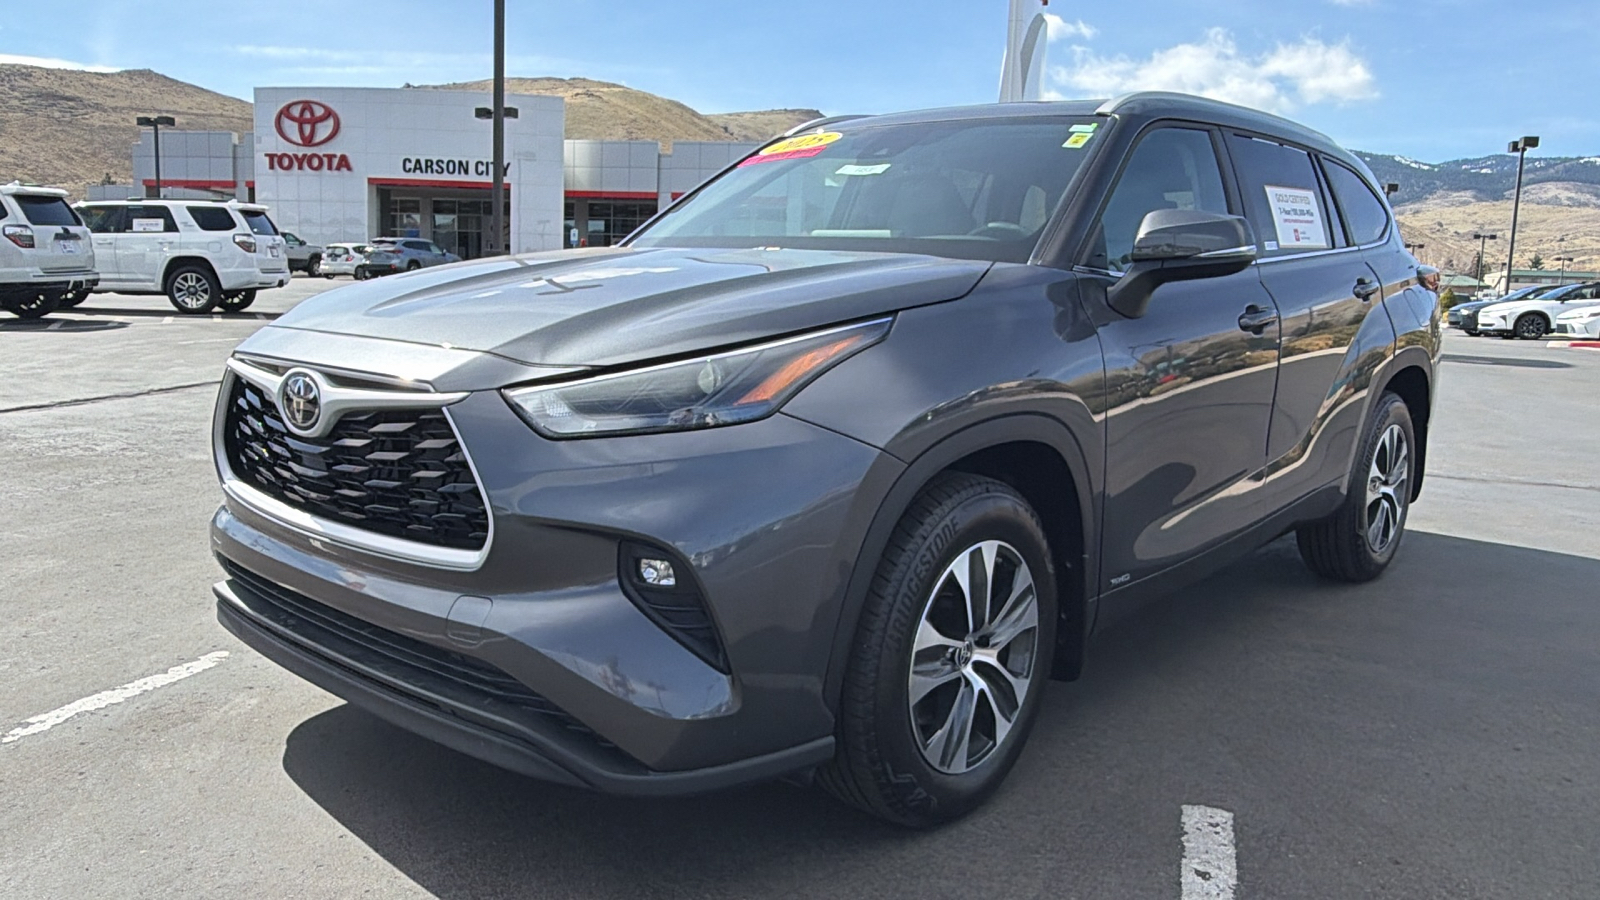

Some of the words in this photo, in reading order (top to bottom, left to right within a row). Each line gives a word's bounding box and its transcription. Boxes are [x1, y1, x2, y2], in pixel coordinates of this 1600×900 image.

[264, 152, 352, 172] TOYOTA
[402, 157, 469, 176] CARSON
[474, 160, 511, 177] CIY
